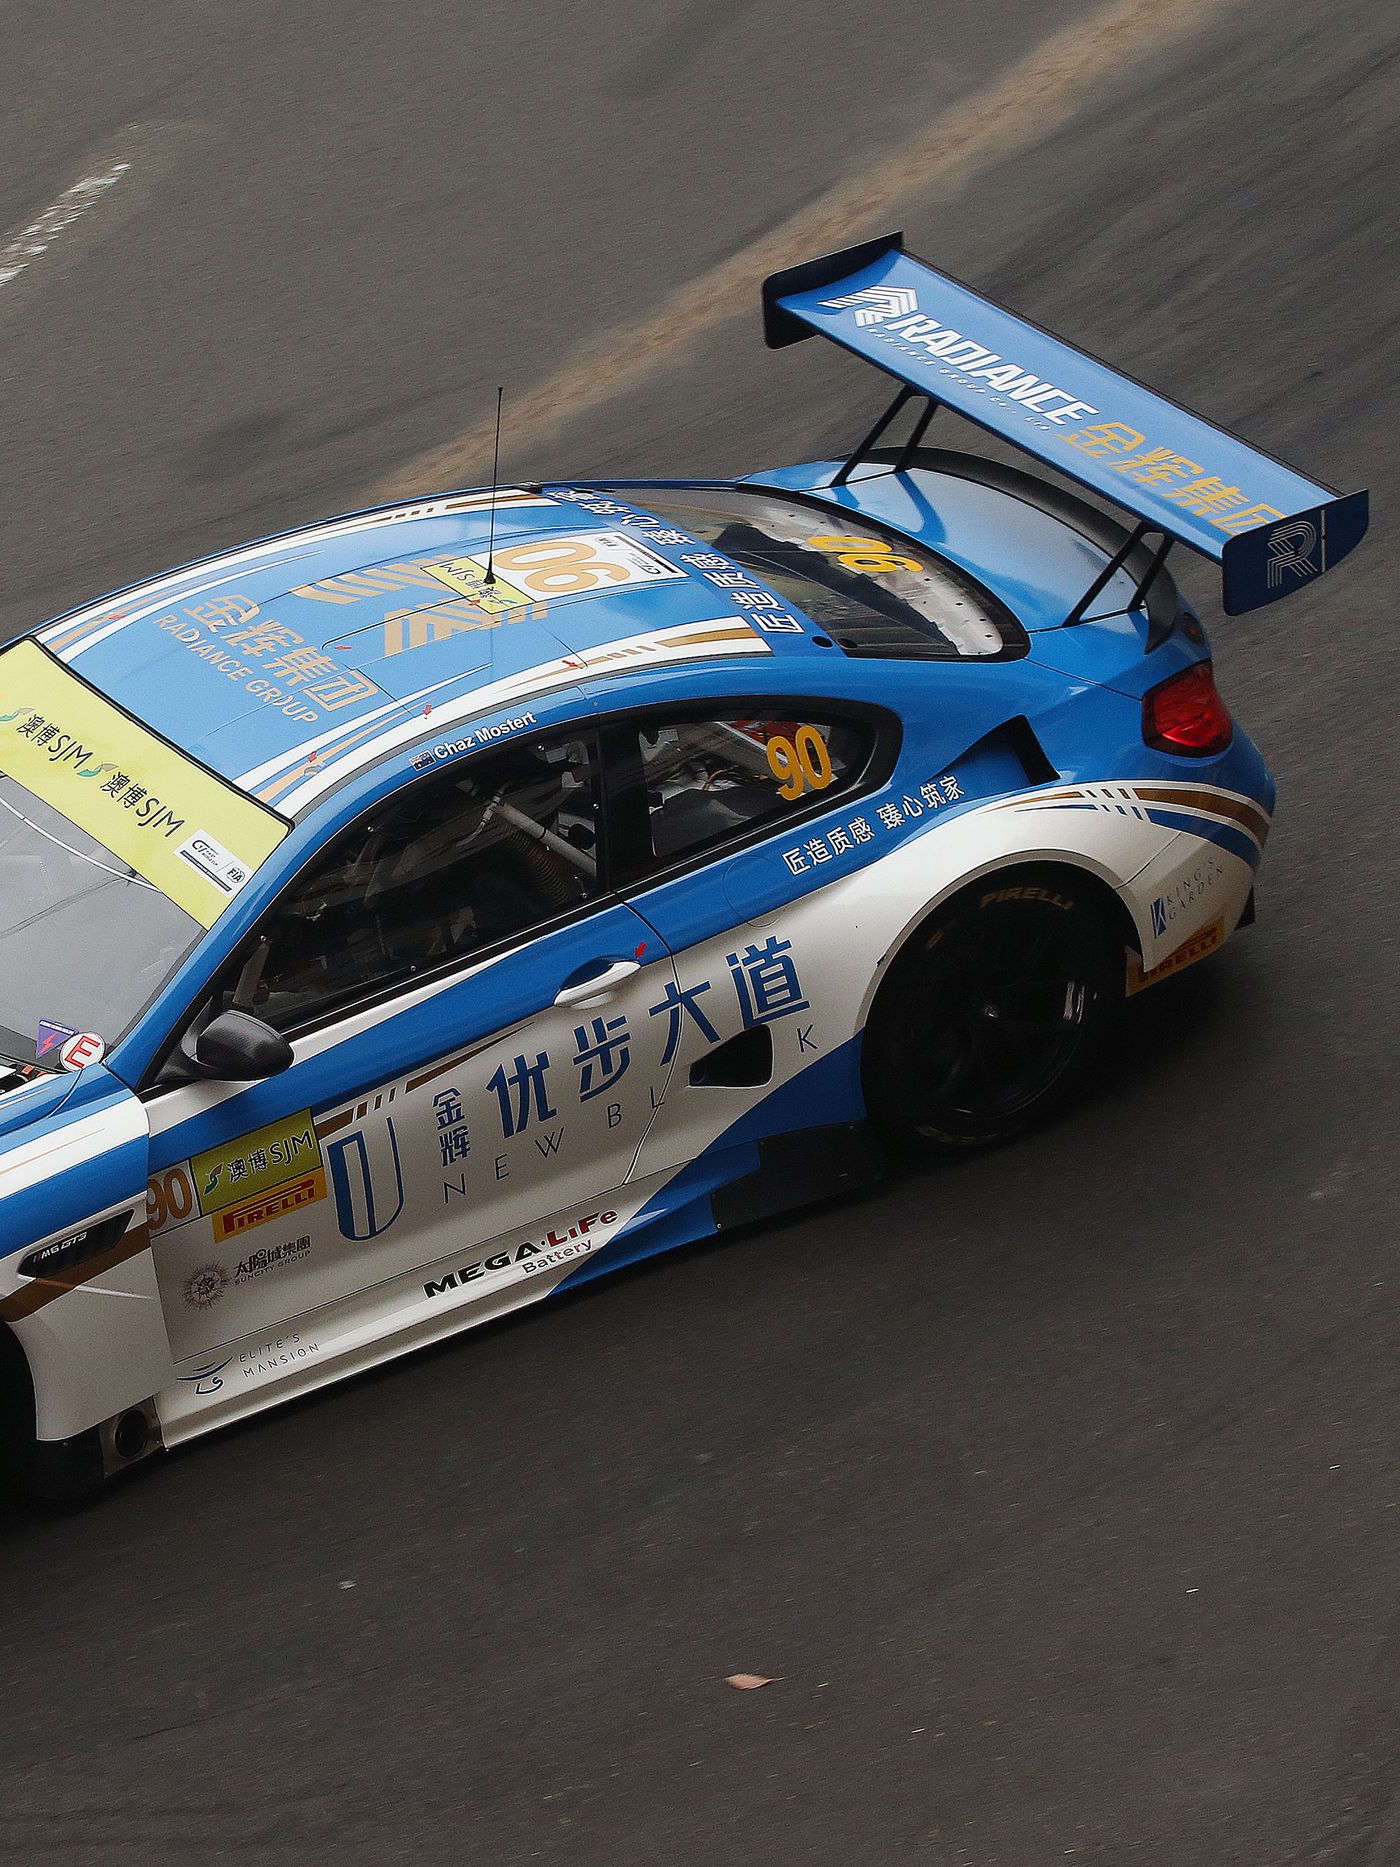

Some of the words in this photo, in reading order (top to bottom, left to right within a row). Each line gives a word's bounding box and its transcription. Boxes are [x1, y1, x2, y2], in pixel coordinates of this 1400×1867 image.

[883, 313, 1099, 426] RADIANCE
[152, 613, 254, 682] RADIANCE
[244, 678, 320, 724] GROUP
[183, 593, 380, 713] 金辉集团
[433, 735, 477, 760] Chaz
[474, 710, 537, 744] Mostert
[767, 725, 833, 801] 90
[781, 816, 876, 877] 匠造质感
[876, 774, 965, 830] 臻心筑家
[63, 1034, 101, 1069] E
[486, 934, 810, 1141] 优步大道
[432, 1087, 471, 1168] 金辉
[146, 1167, 193, 1231] 90
[443, 1126, 565, 1204] NEW
[60, 1231, 88, 1250] GT3
[222, 1177, 316, 1235] PIRELLI
[234, 1266, 275, 1286] SUNCITY
[277, 1250, 312, 1268] GROUP
[521, 1238, 593, 1274] Battery
[242, 1343, 320, 1378] MANSION
